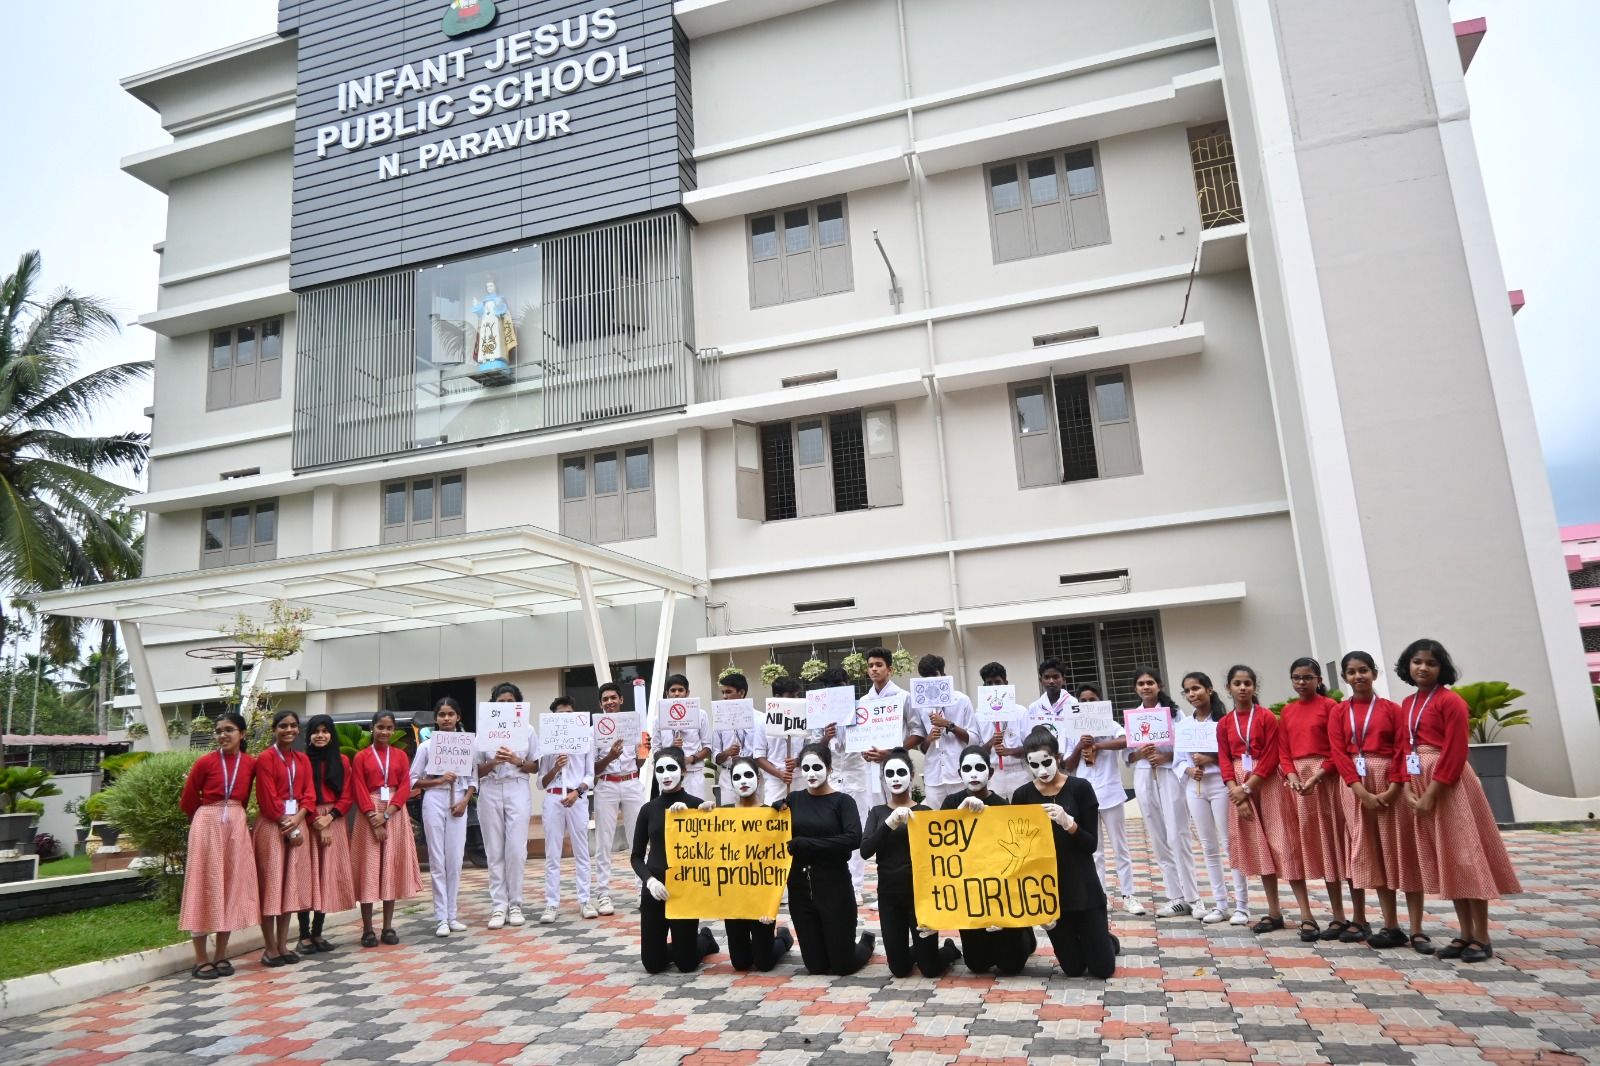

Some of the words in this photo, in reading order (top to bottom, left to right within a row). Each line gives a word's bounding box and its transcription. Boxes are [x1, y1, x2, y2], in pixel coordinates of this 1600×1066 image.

[338, 47, 473, 113] INFANT
[484, 8, 618, 70] JESUS
[316, 95, 455, 158] PUBLIC
[468, 46, 644, 118] SCHOOL
[378, 152, 409, 180] N.
[419, 110, 572, 170] PARAVUR
[873, 704, 898, 716] STOP
[498, 721, 507, 729] NO
[766, 712, 784, 725] NO
[488, 731, 511, 739] DRUGS
[544, 737, 560, 745] SAY
[1149, 731, 1170, 741] DRUGS
[1182, 728, 1214, 740] STOP
[435, 745, 459, 756] DRAG
[554, 743, 582, 751] DRUGS
[673, 816, 737, 838] Together,
[741, 819, 763, 833] we
[766, 818, 789, 832] can
[927, 818, 979, 853] say
[673, 842, 715, 860] tackle
[719, 842, 741, 861] the
[931, 854, 964, 879] no
[673, 865, 711, 887] drug
[717, 862, 788, 896] problem
[931, 884, 959, 911] to
[963, 874, 1059, 919] DRUGS
